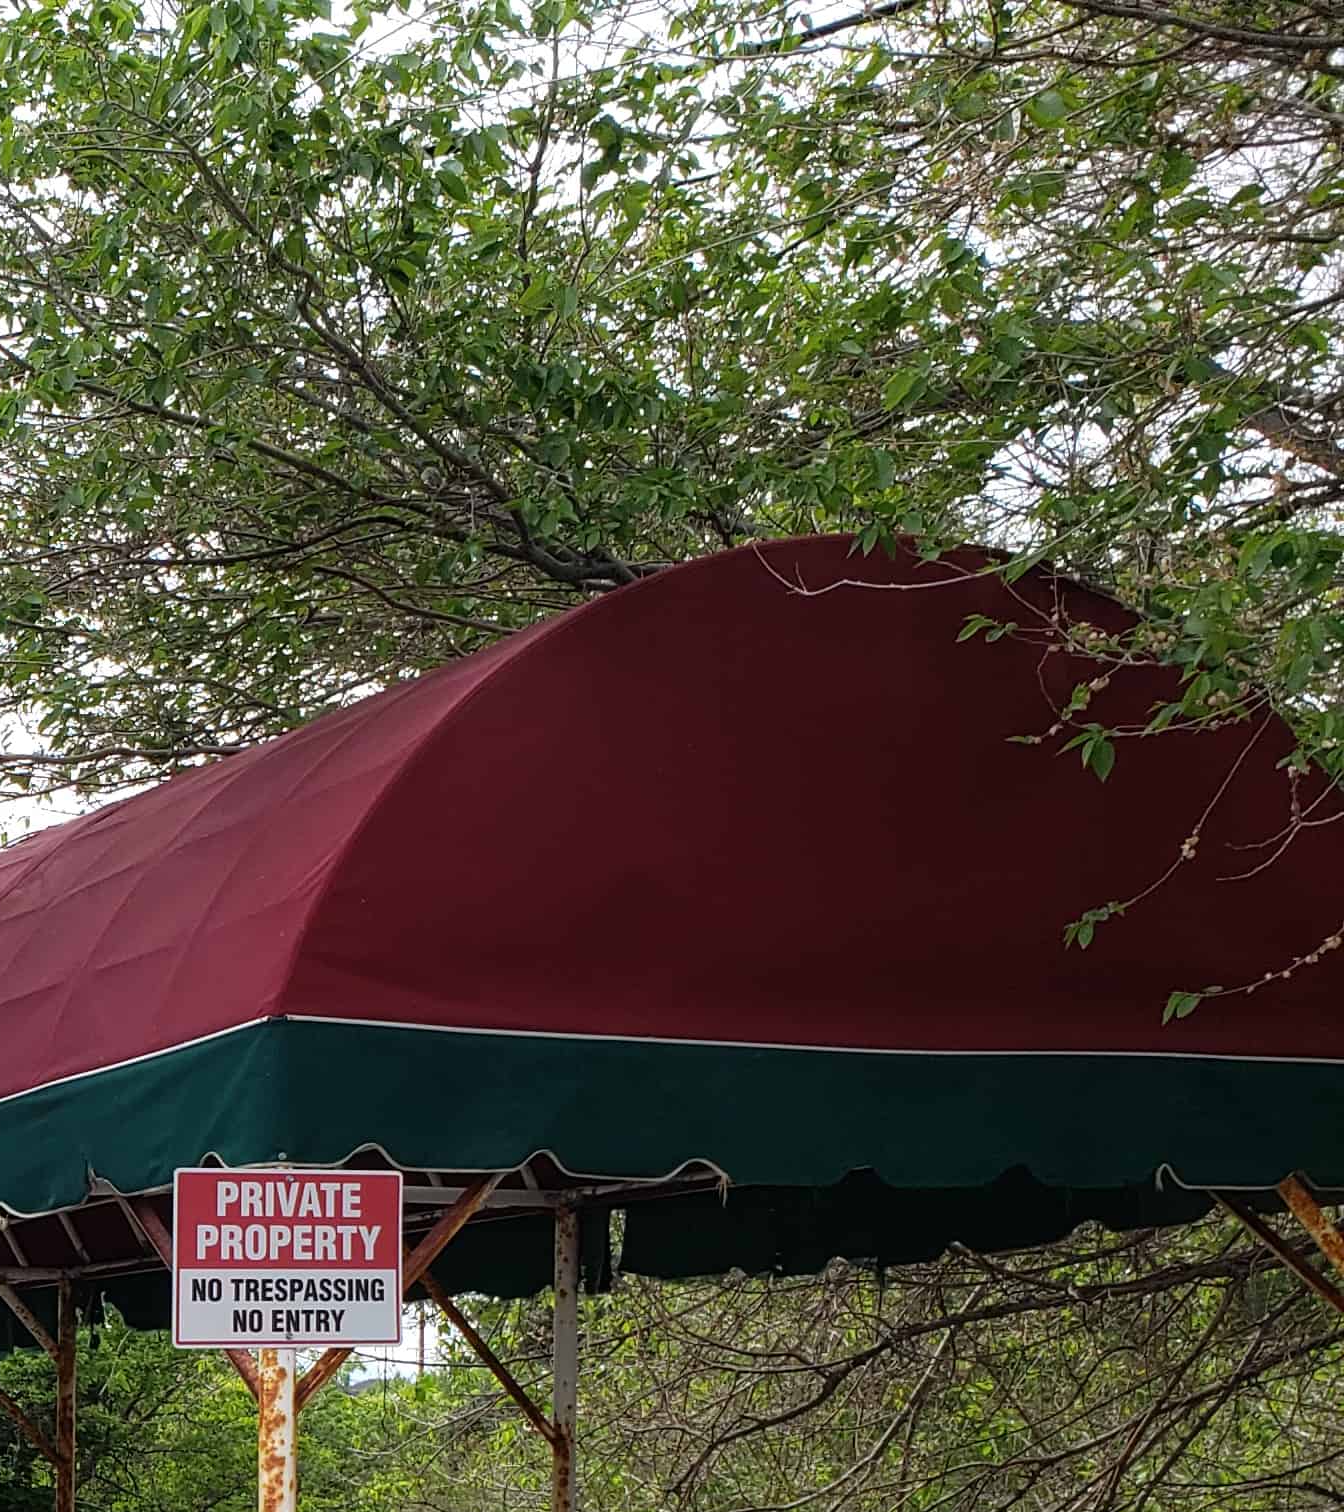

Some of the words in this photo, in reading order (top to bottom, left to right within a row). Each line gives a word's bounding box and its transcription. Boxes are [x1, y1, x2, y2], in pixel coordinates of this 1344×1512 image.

[216, 1180, 362, 1218] PRIVATE
[196, 1223, 382, 1261] PROPERTY
[191, 1278, 222, 1302] NO
[230, 1278, 385, 1302] TRESPASSING
[232, 1309, 263, 1333] NO
[271, 1309, 346, 1334] ENTRY
